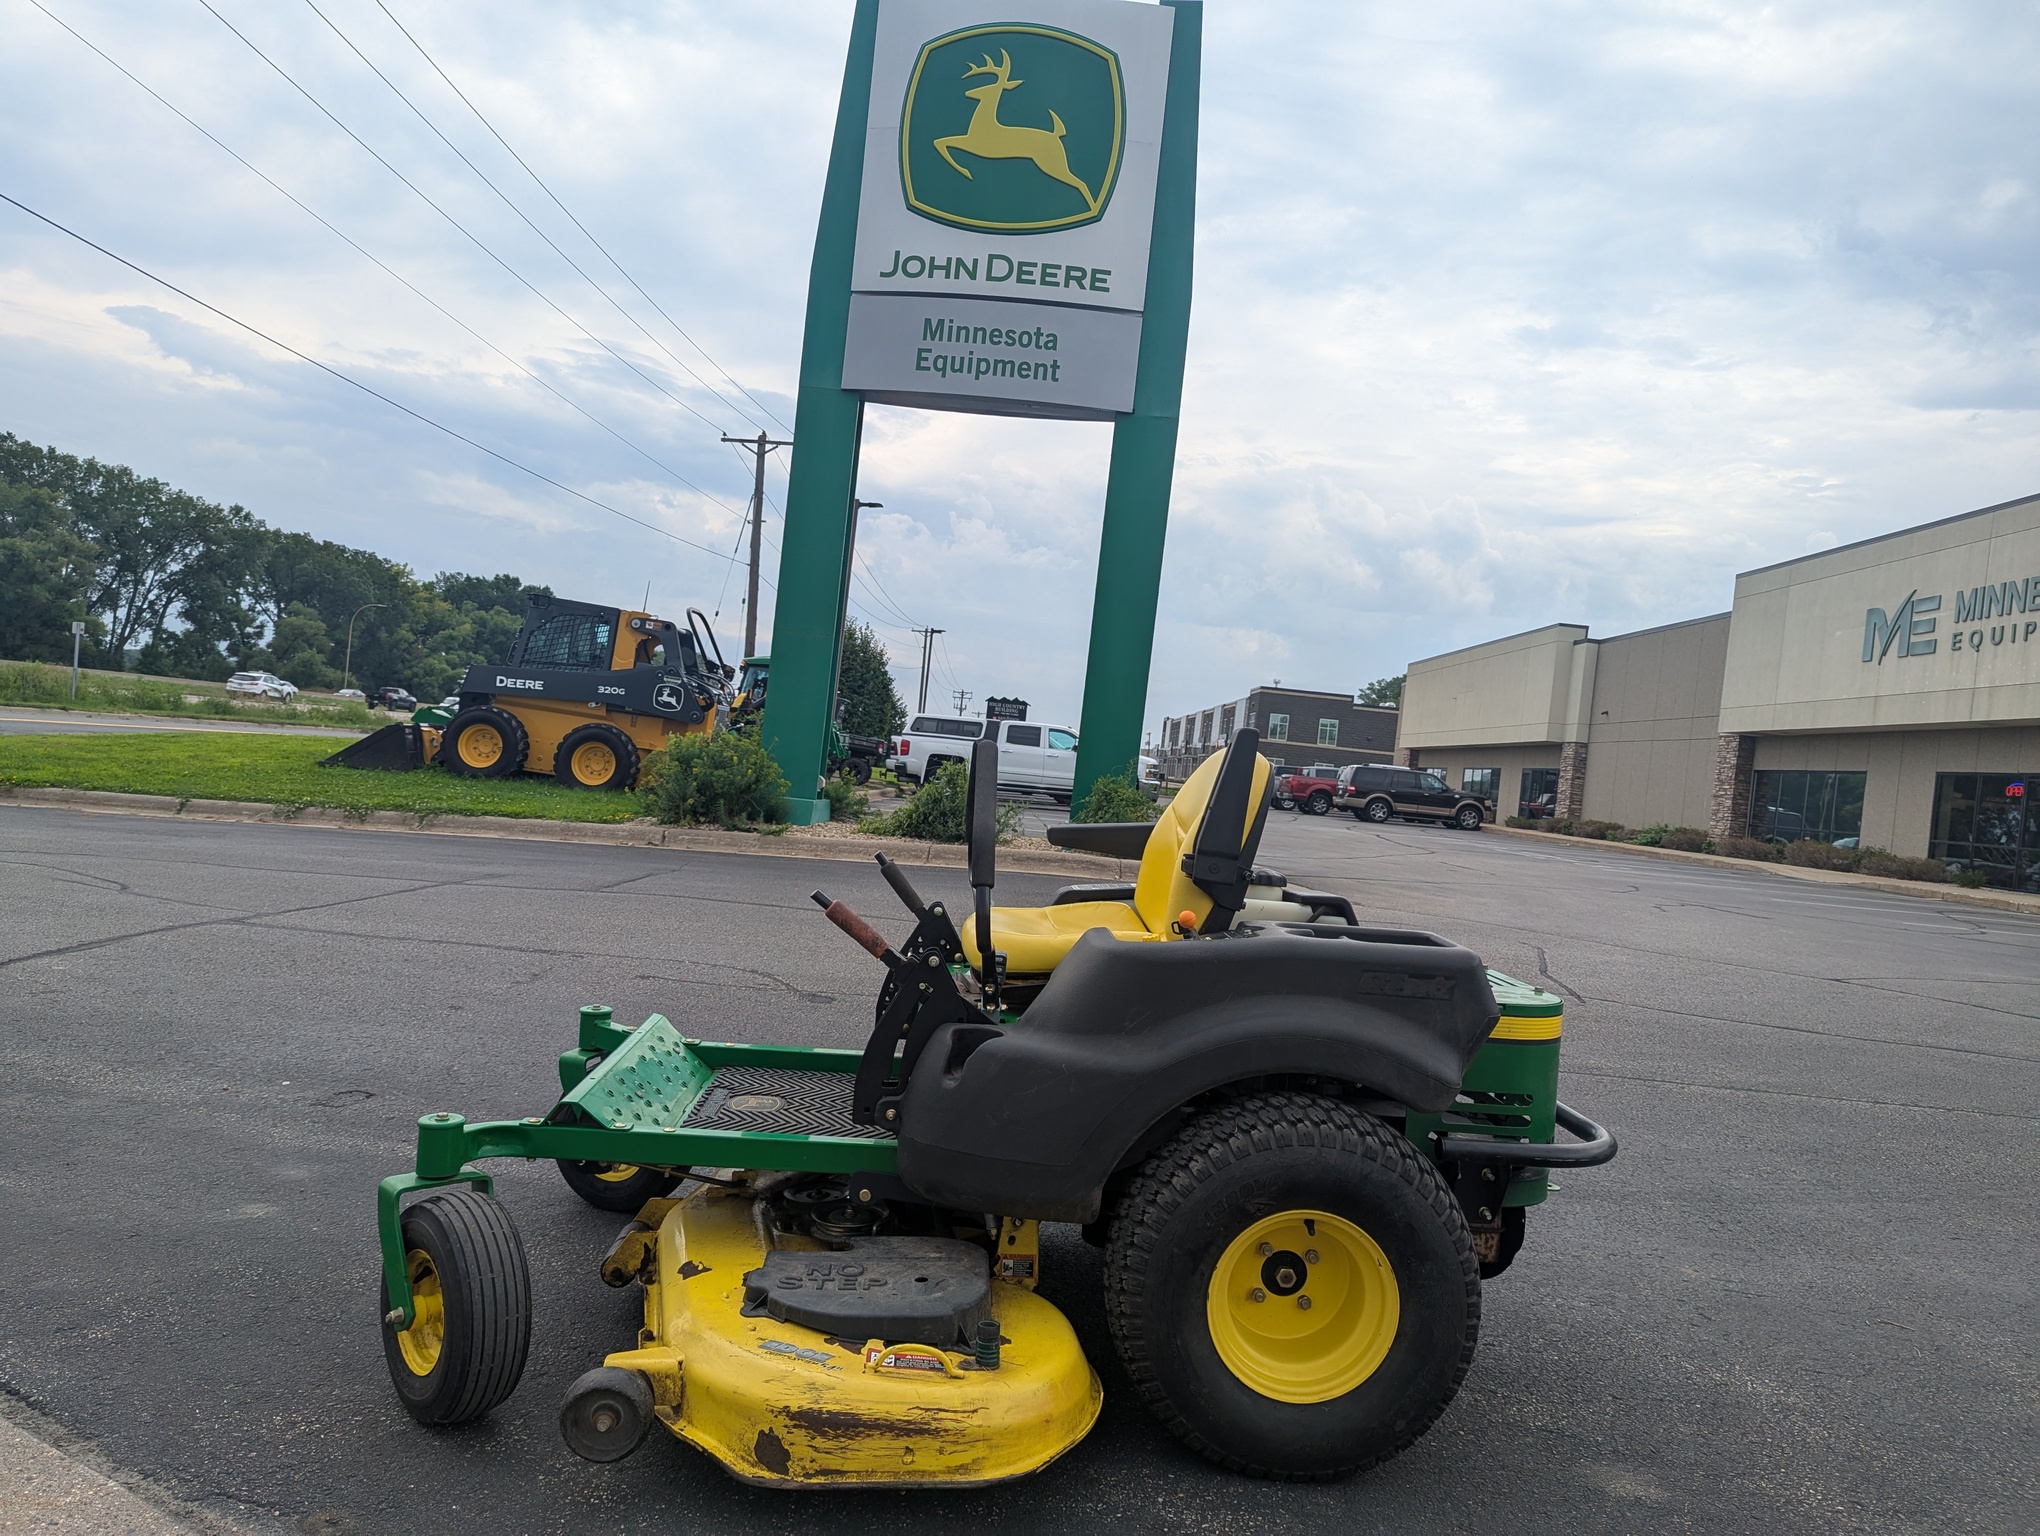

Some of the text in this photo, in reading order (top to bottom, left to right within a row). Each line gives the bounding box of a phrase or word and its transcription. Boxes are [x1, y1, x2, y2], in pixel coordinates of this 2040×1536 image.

[879, 250, 1112, 293] JOHN DEERE
[922, 317, 1058, 351] Minnesota
[915, 347, 1061, 382] Equipment
[1951, 620, 2037, 652] EQUIP
[495, 675, 544, 690] DEERE
[597, 685, 626, 695] 320G
[805, 1263, 865, 1278] NO
[776, 1276, 890, 1291] STEP
[757, 1339, 836, 1363] EDGE
